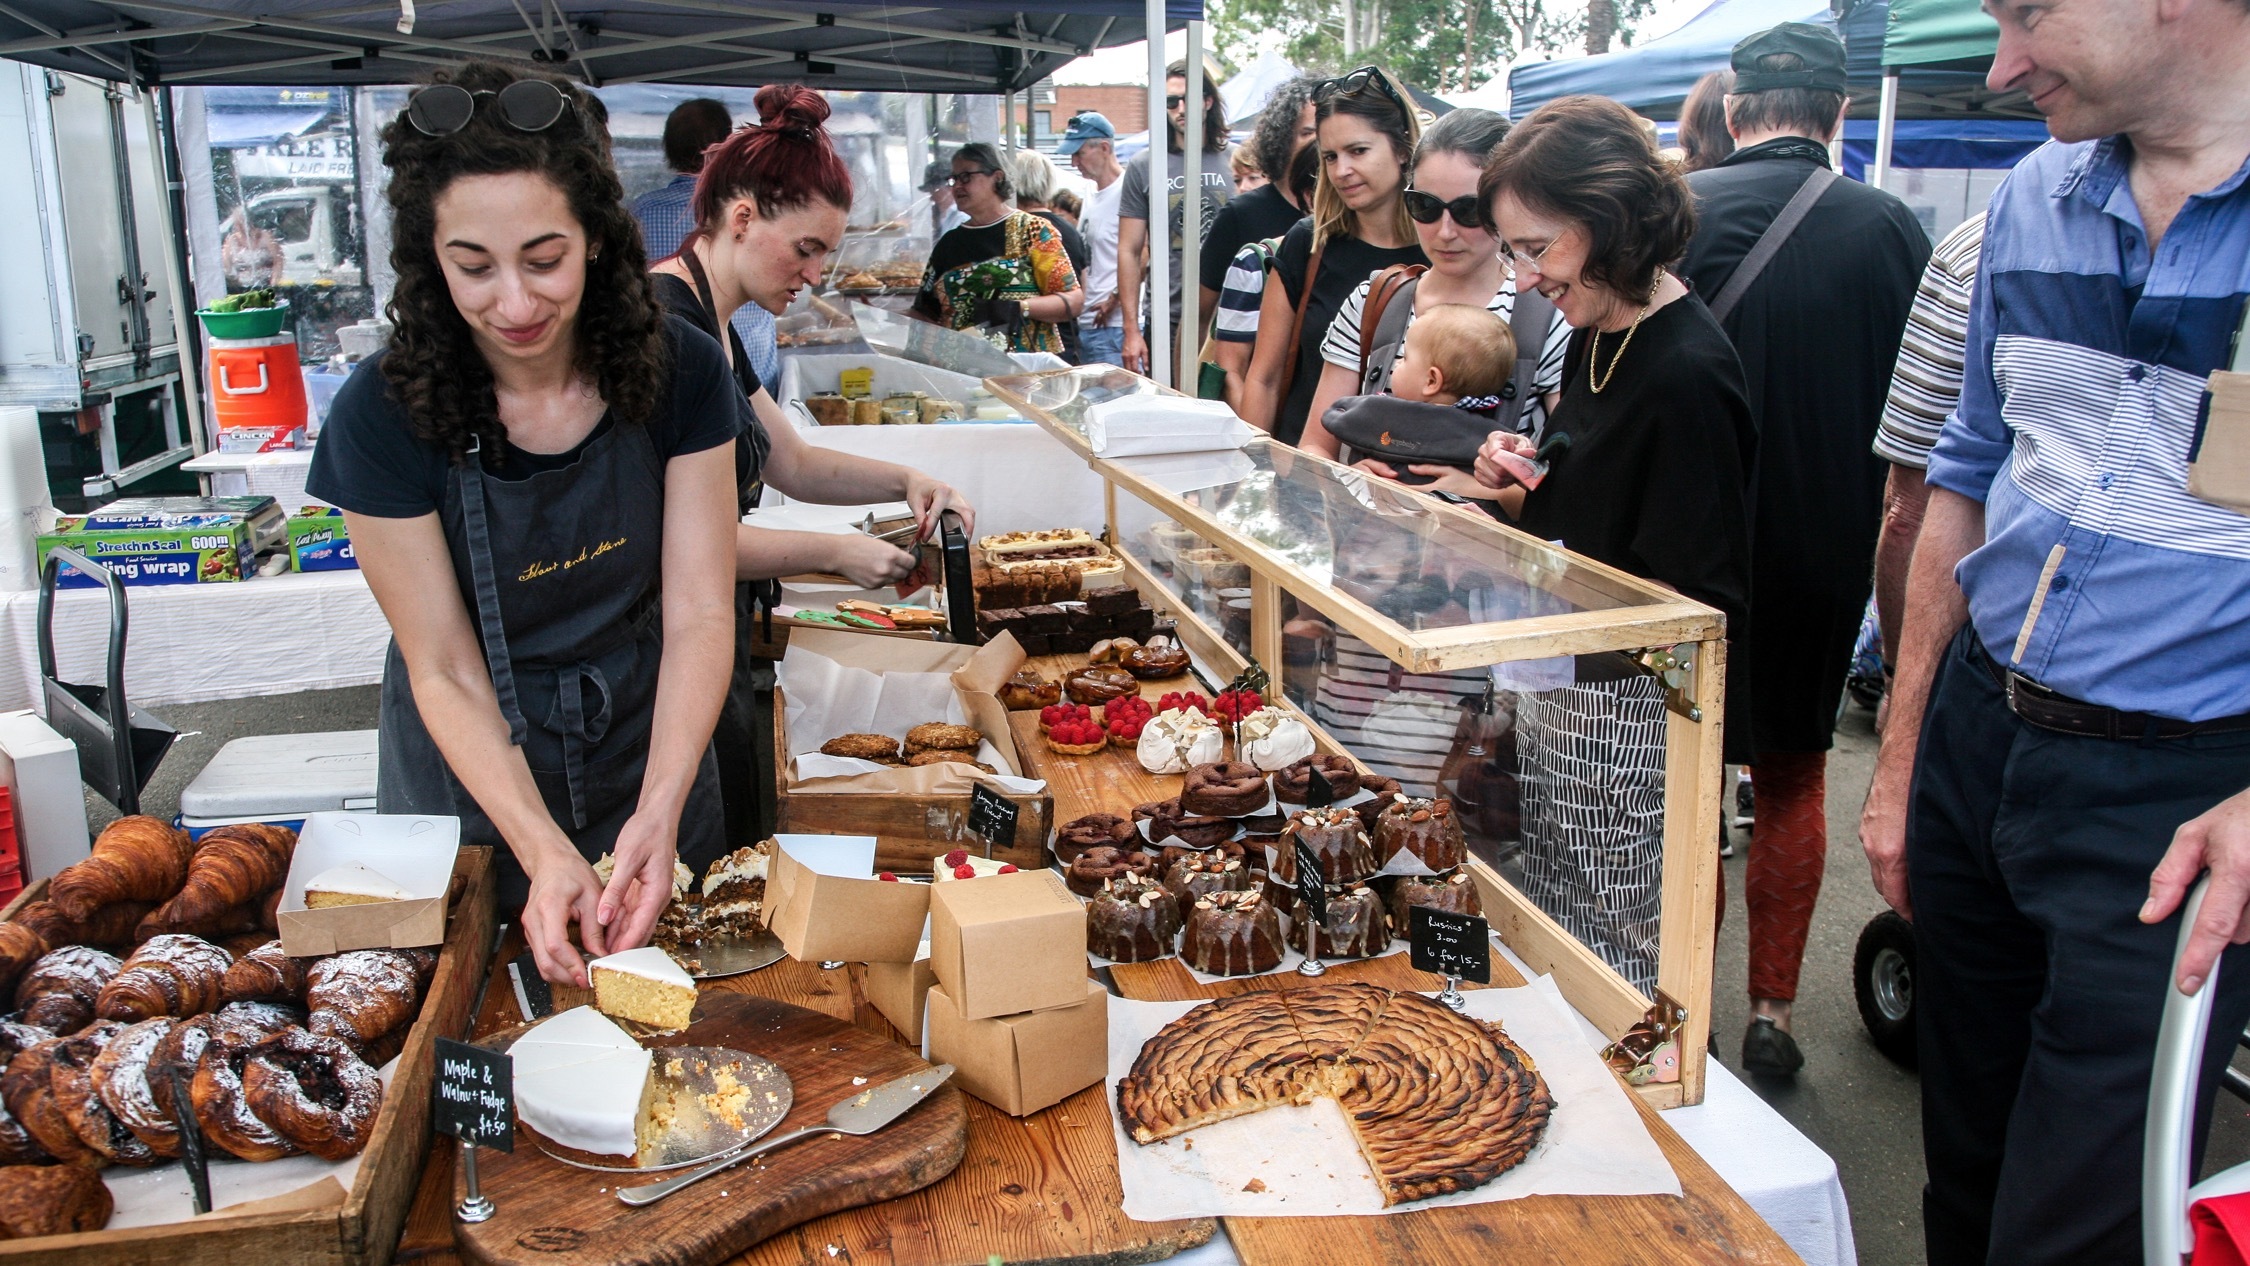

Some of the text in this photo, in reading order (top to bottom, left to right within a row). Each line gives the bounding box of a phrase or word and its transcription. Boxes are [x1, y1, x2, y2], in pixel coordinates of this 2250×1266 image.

[289, 162, 322, 175] LAID
[564, 546, 587, 569] and
[591, 538, 627, 560] Stone
[102, 559, 139, 579] ling
[143, 562, 191, 577] wrap
[1436, 933, 1458, 944] 3.00
[1427, 946, 1435, 957] 6
[1440, 949, 1457, 961] for
[444, 1059, 493, 1085] Maple &
[441, 1081, 506, 1120] Walnut Fudge
[479, 1114, 506, 1137] $4.50
